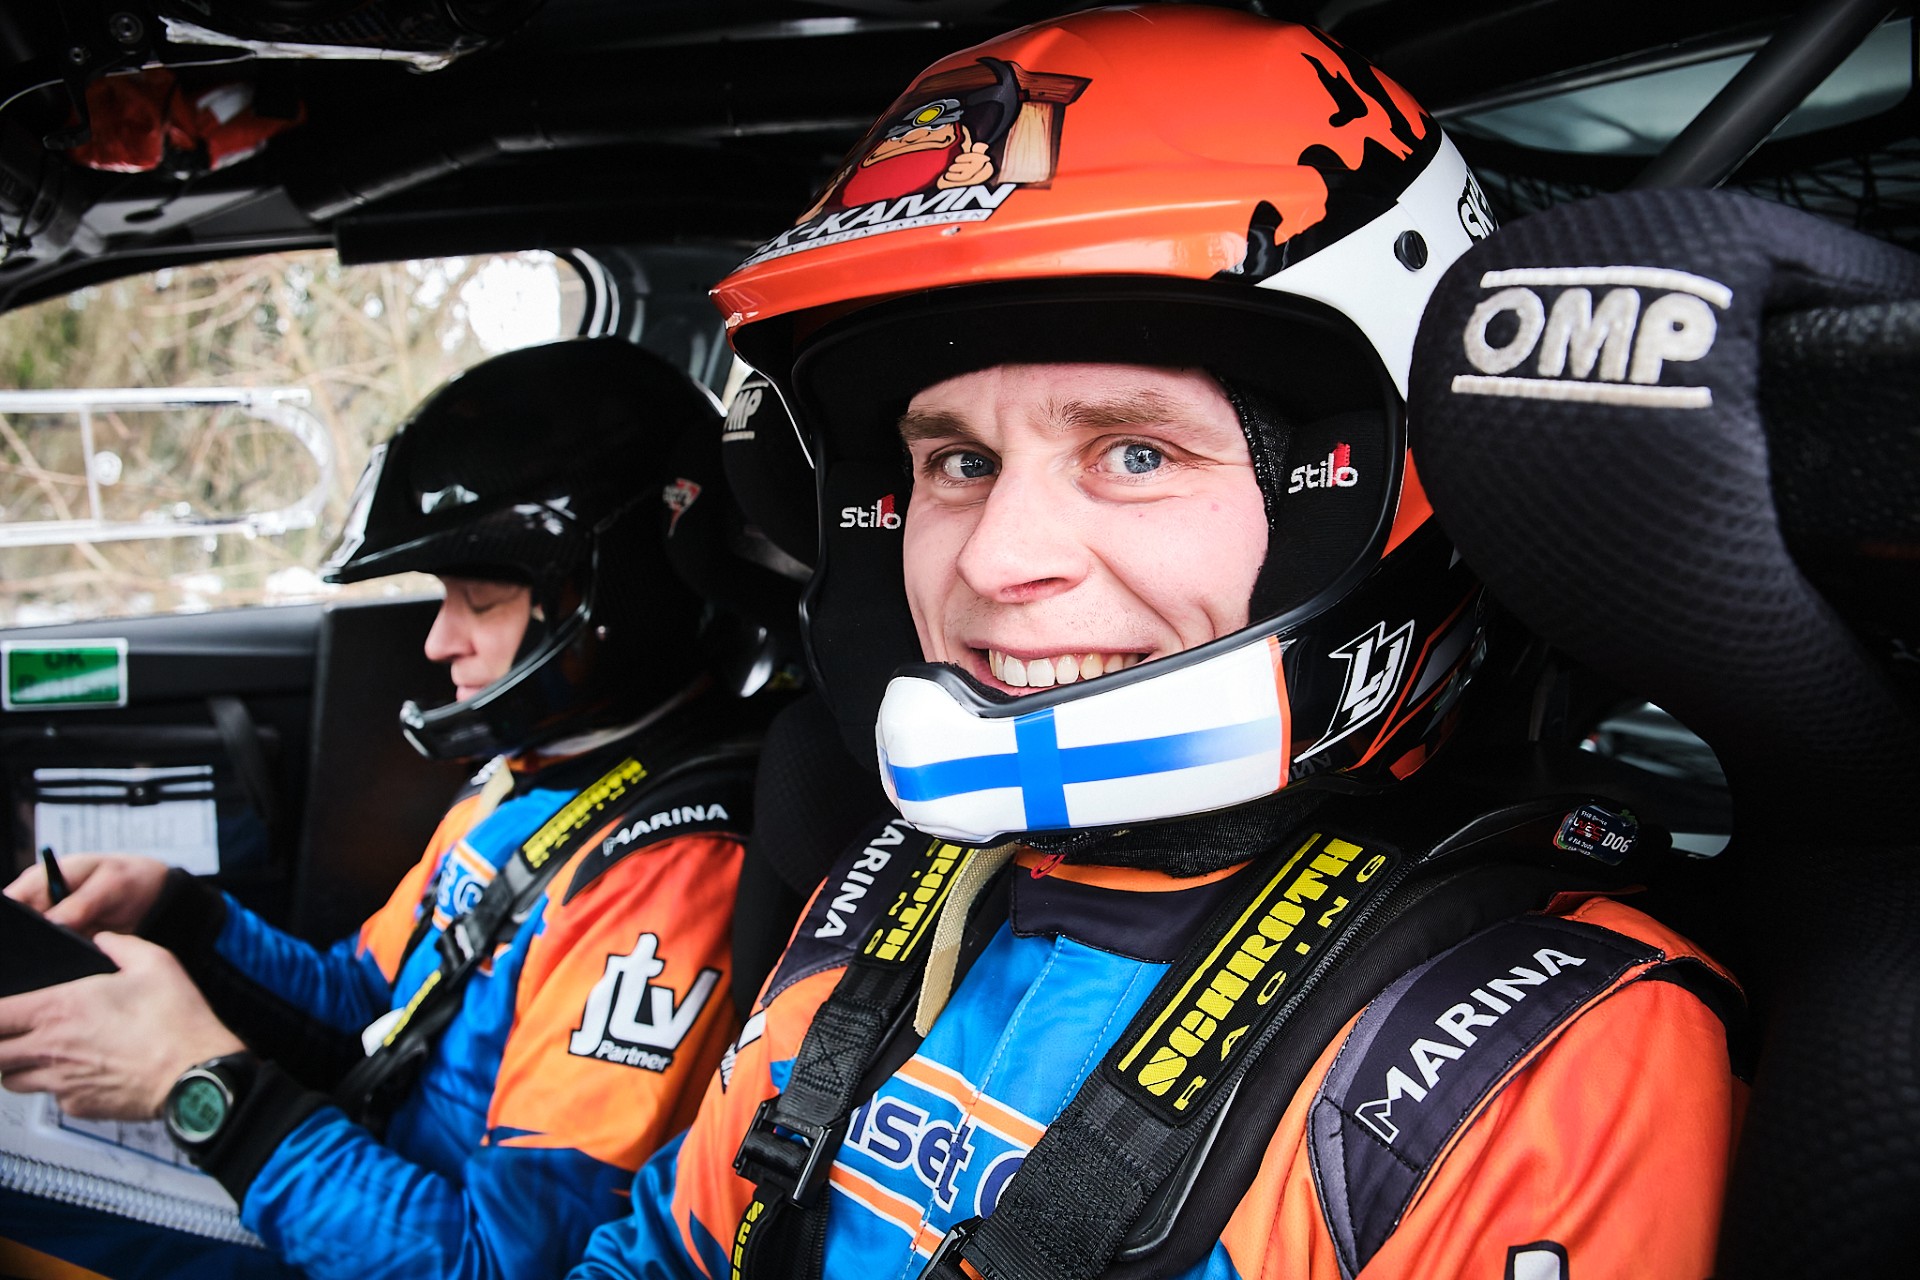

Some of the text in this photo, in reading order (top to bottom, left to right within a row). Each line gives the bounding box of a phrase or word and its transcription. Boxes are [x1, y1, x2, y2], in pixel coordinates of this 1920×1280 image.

[1463, 286, 1718, 385] OMP
[723, 388, 763, 431] MP
[602, 803, 729, 857] MARINA
[814, 818, 917, 939] ARINA
[1137, 838, 1364, 1096] SCHROTH
[1173, 854, 1387, 1111] RACING
[595, 1039, 671, 1072] Partner
[1354, 948, 1587, 1145] MARINA
